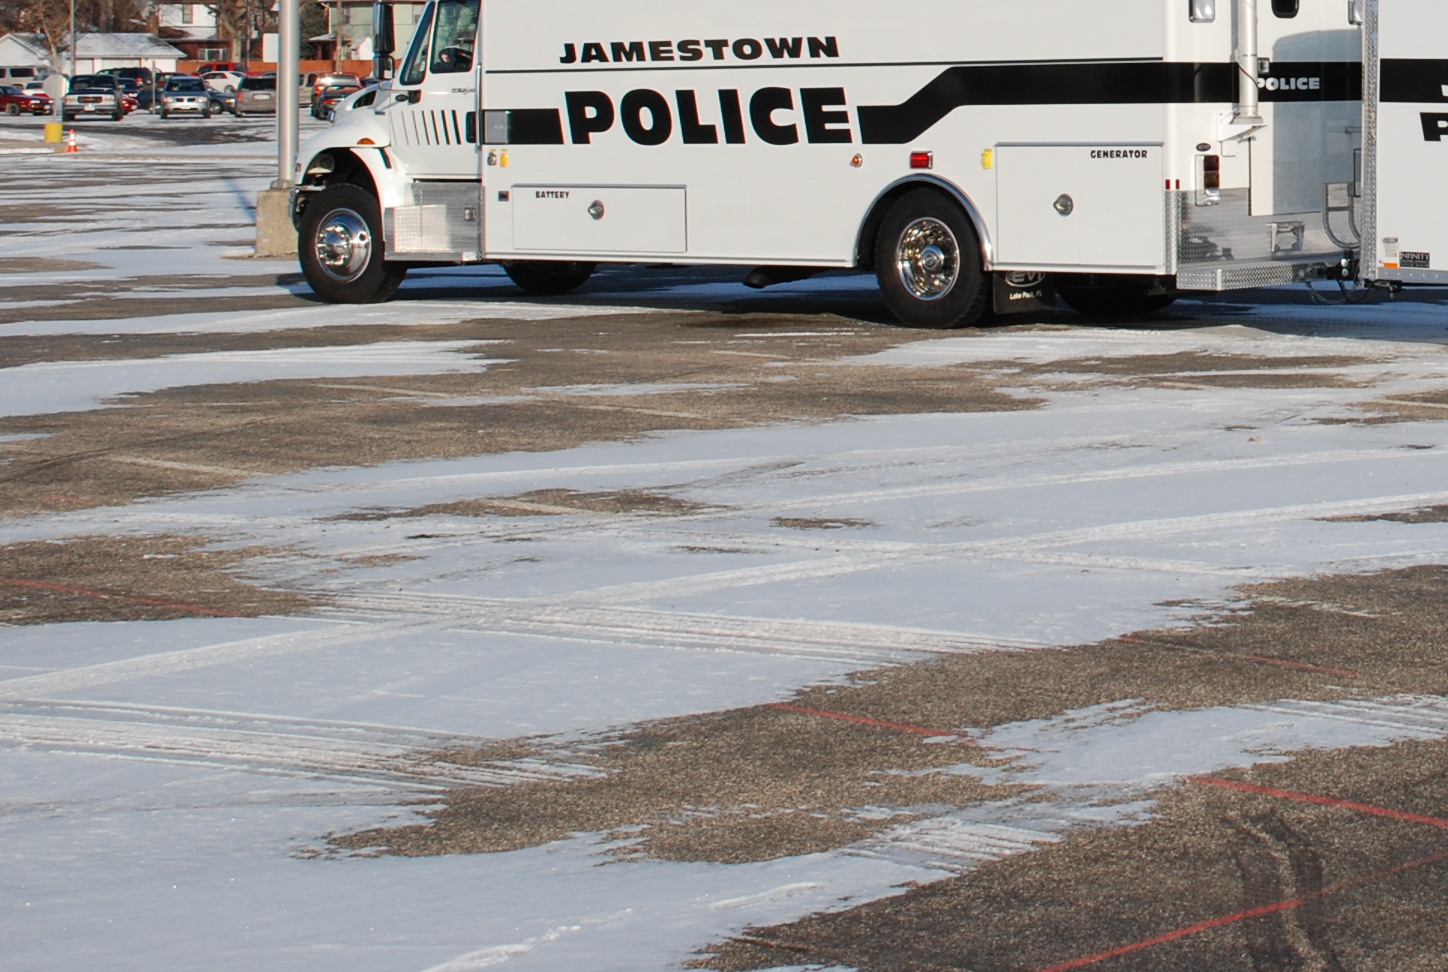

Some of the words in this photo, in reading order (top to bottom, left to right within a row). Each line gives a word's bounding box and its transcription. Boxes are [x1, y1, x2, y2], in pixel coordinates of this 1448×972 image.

[559, 36, 840, 64] JAMESTOWN
[564, 87, 853, 146] POLICE
[1090, 149, 1148, 159] GENERATOR
[535, 190, 570, 199] BATTERY
